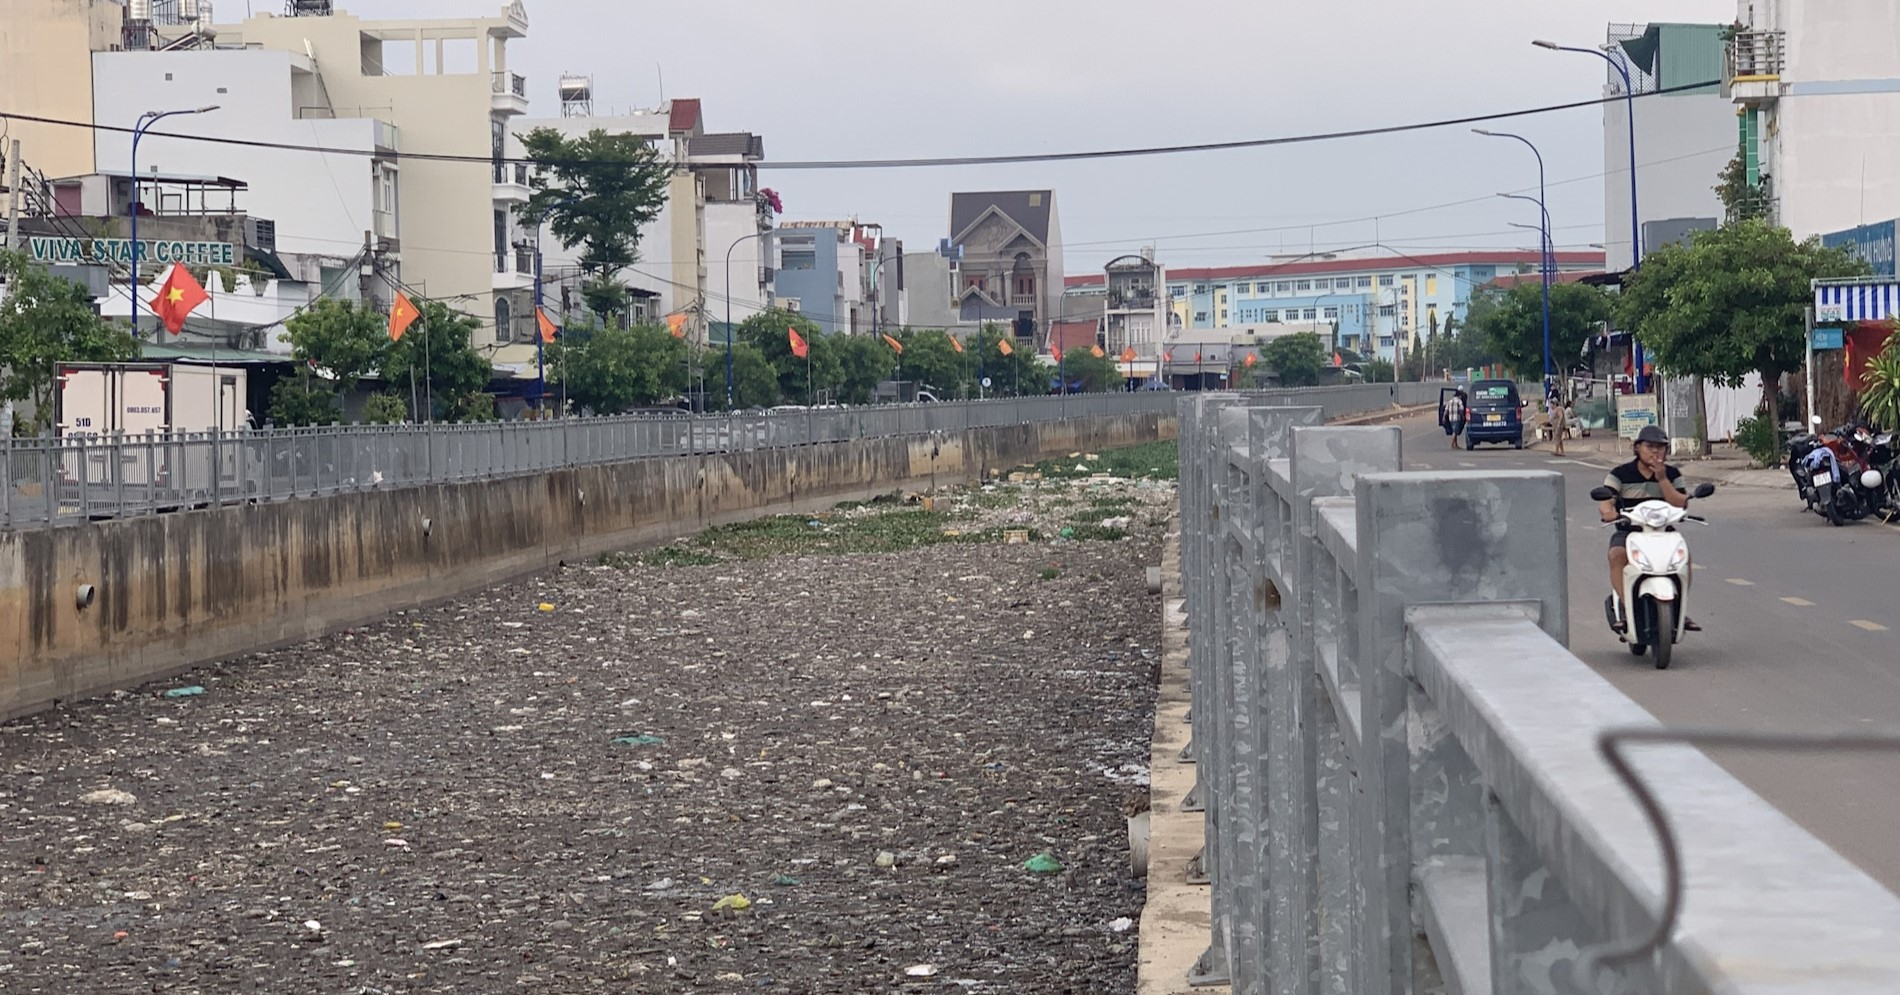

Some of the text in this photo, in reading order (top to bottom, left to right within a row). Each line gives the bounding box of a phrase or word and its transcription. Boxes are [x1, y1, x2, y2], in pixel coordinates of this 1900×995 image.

[31, 237, 234, 265] VIVA STAR COFFEE
[76, 417, 91, 427] 51D
